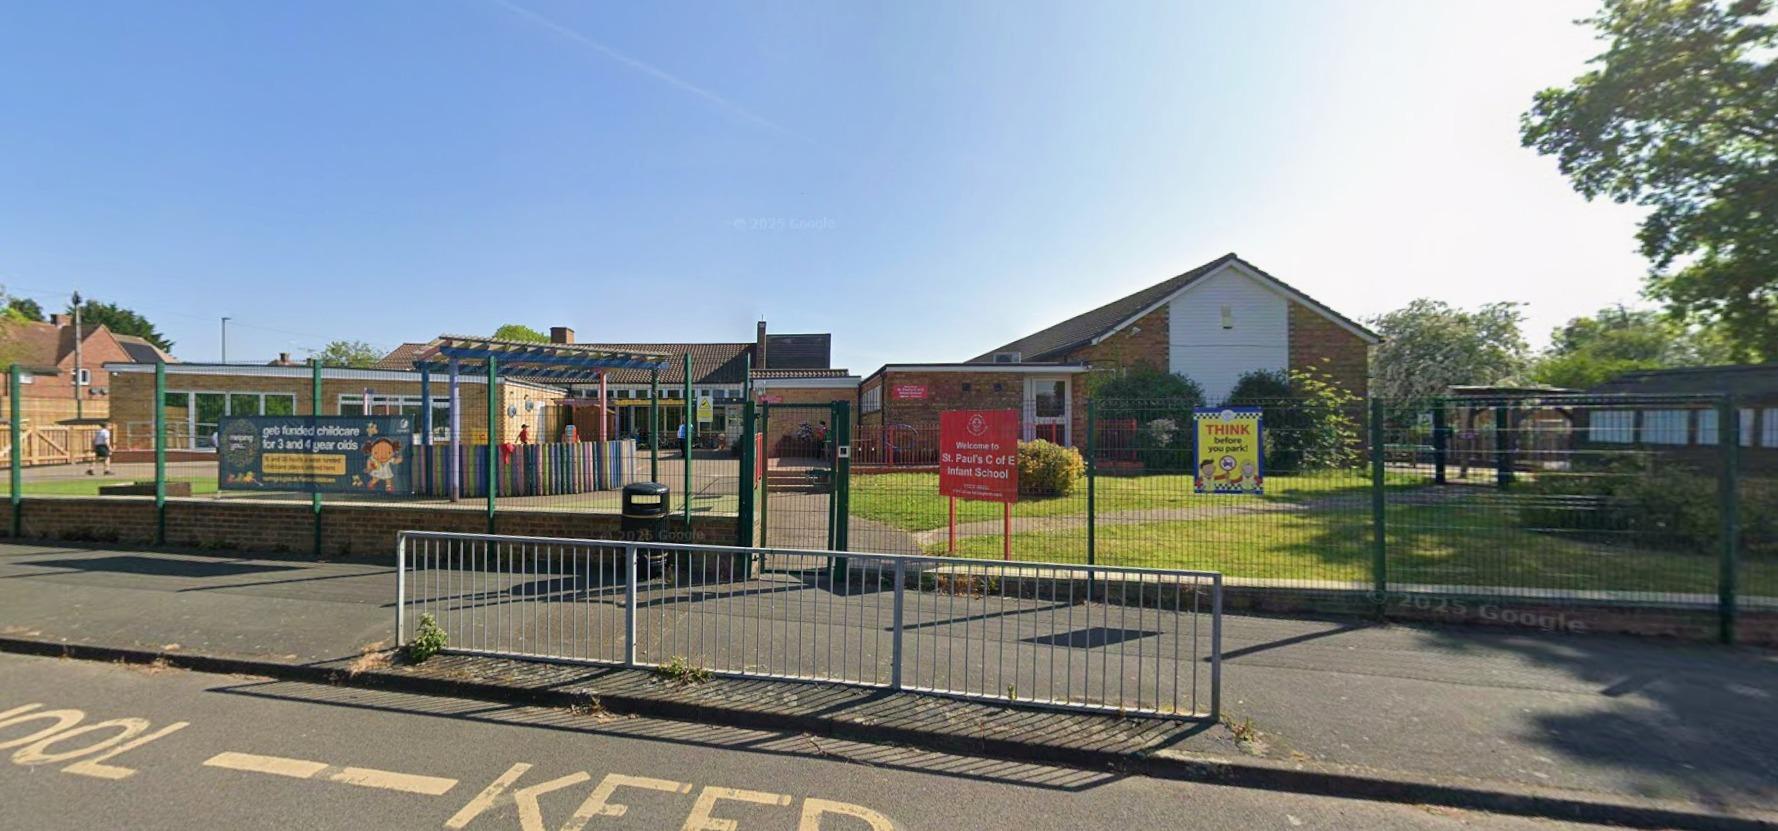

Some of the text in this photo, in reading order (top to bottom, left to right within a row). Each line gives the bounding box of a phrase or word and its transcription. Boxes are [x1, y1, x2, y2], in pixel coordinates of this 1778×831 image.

[262, 425, 360, 438] get funded childcare
[1206, 424, 1250, 435] THINK
[262, 439, 359, 453] for 3 and 4 year olds
[955, 441, 989, 450] Welcome
[1214, 436, 1242, 444] before
[1207, 444, 1249, 453] you park!
[942, 453, 1016, 466] St. Paul's C of E
[947, 466, 1009, 479] Infant School
[0, 703, 191, 780] OOL
